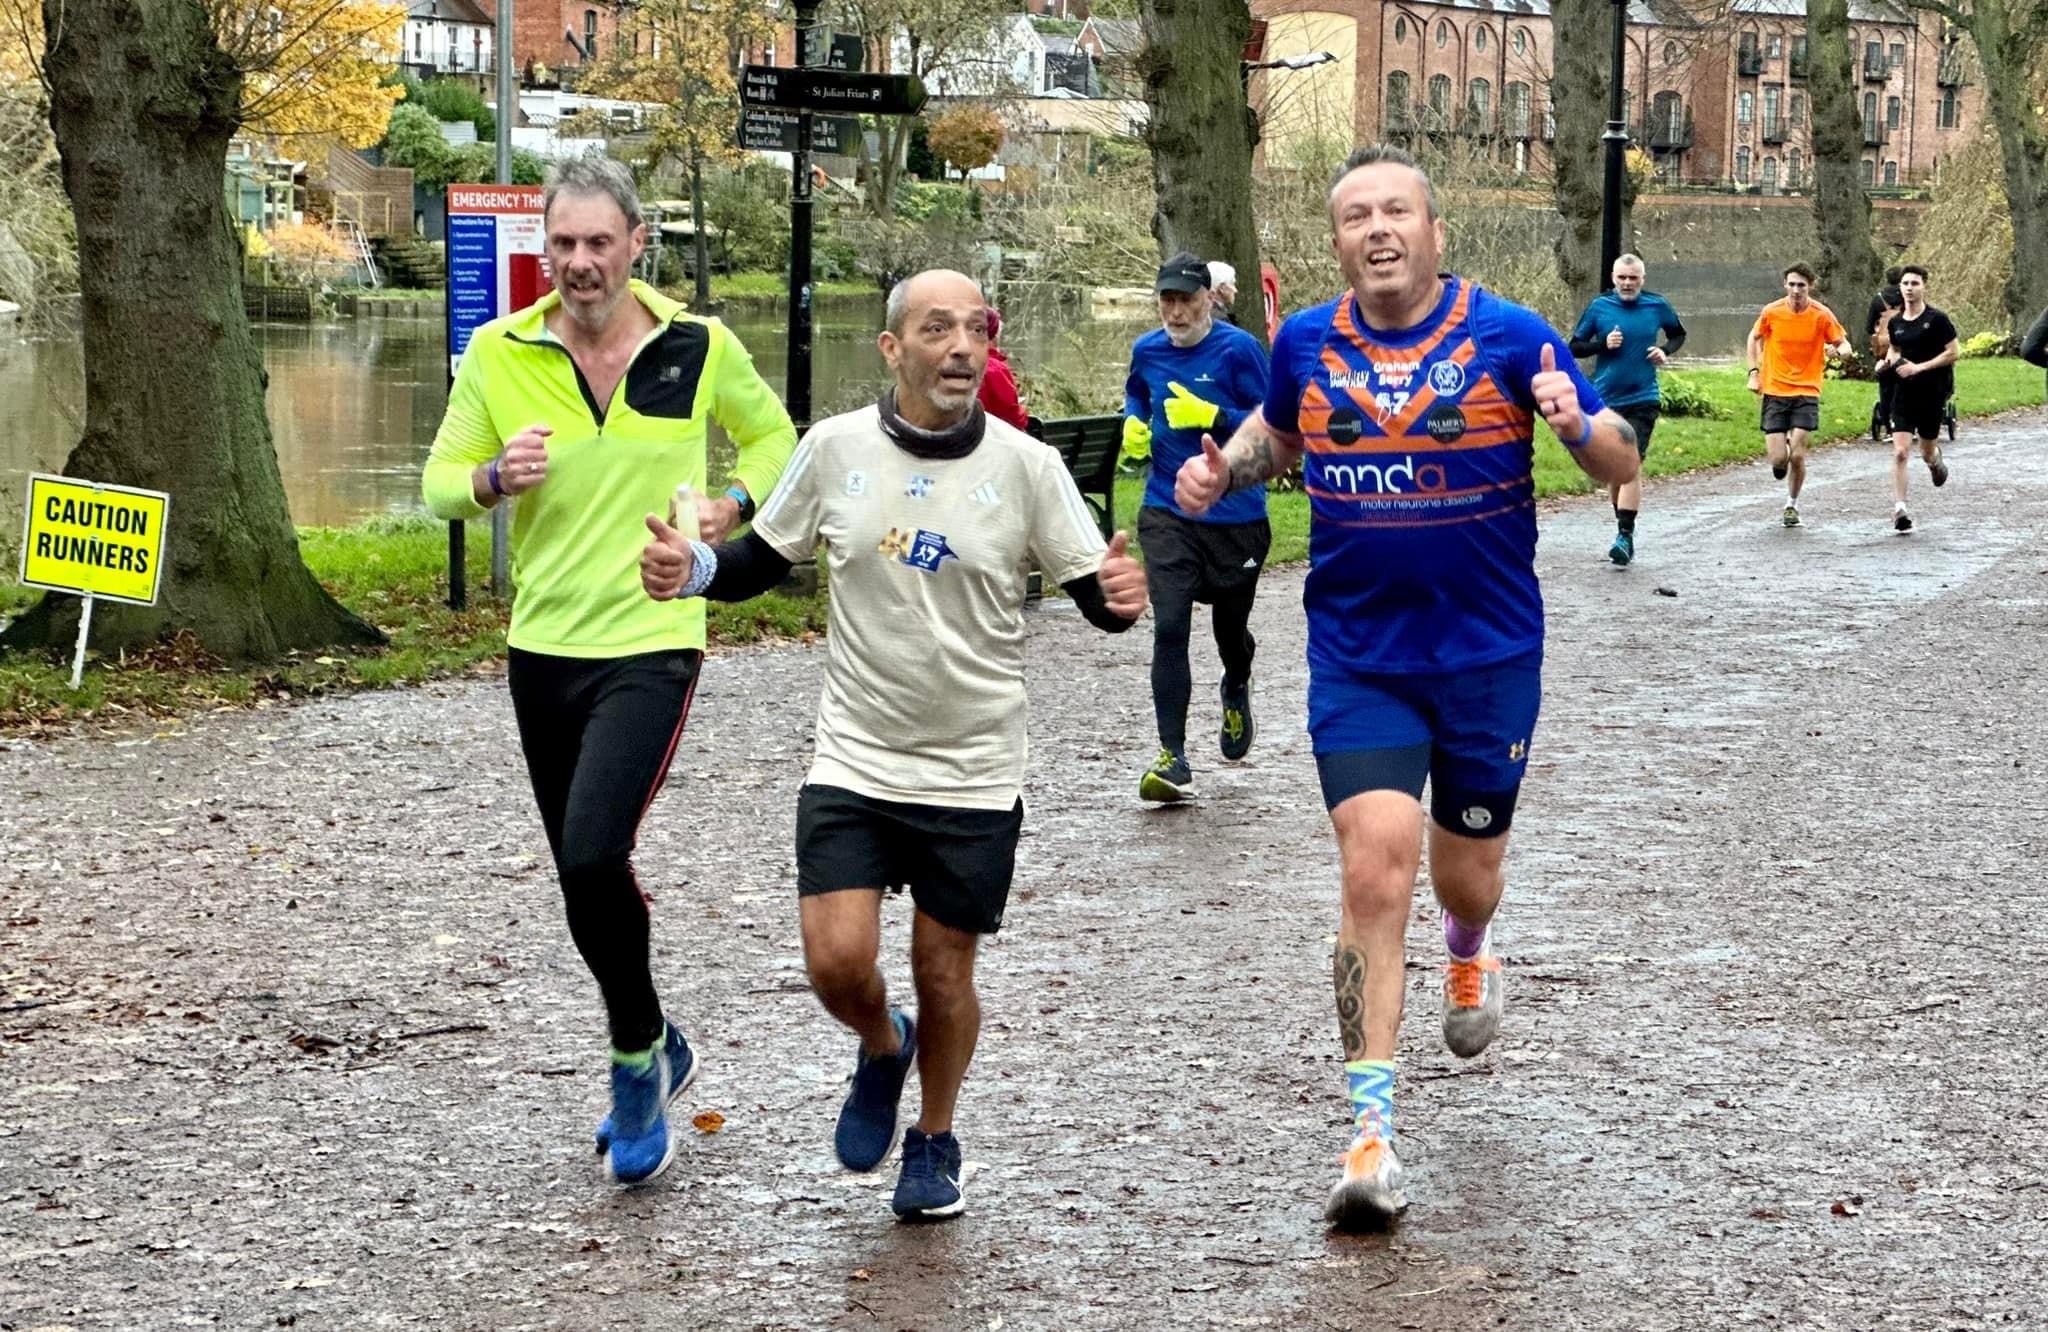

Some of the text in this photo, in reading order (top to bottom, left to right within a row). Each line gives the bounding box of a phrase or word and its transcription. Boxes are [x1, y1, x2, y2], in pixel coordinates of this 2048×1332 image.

[812, 86, 821, 96] St
[822, 87, 845, 98] Julian
[847, 88, 868, 98] Friars
[452, 191, 520, 209] EMERGENCY
[1373, 360, 1420, 374] Graham
[1378, 373, 1413, 387] Berry
[1324, 455, 1447, 494] mnda
[1360, 498, 1392, 510] motor
[46, 496, 147, 536] CAUTION
[37, 532, 149, 573] RUNNERS
